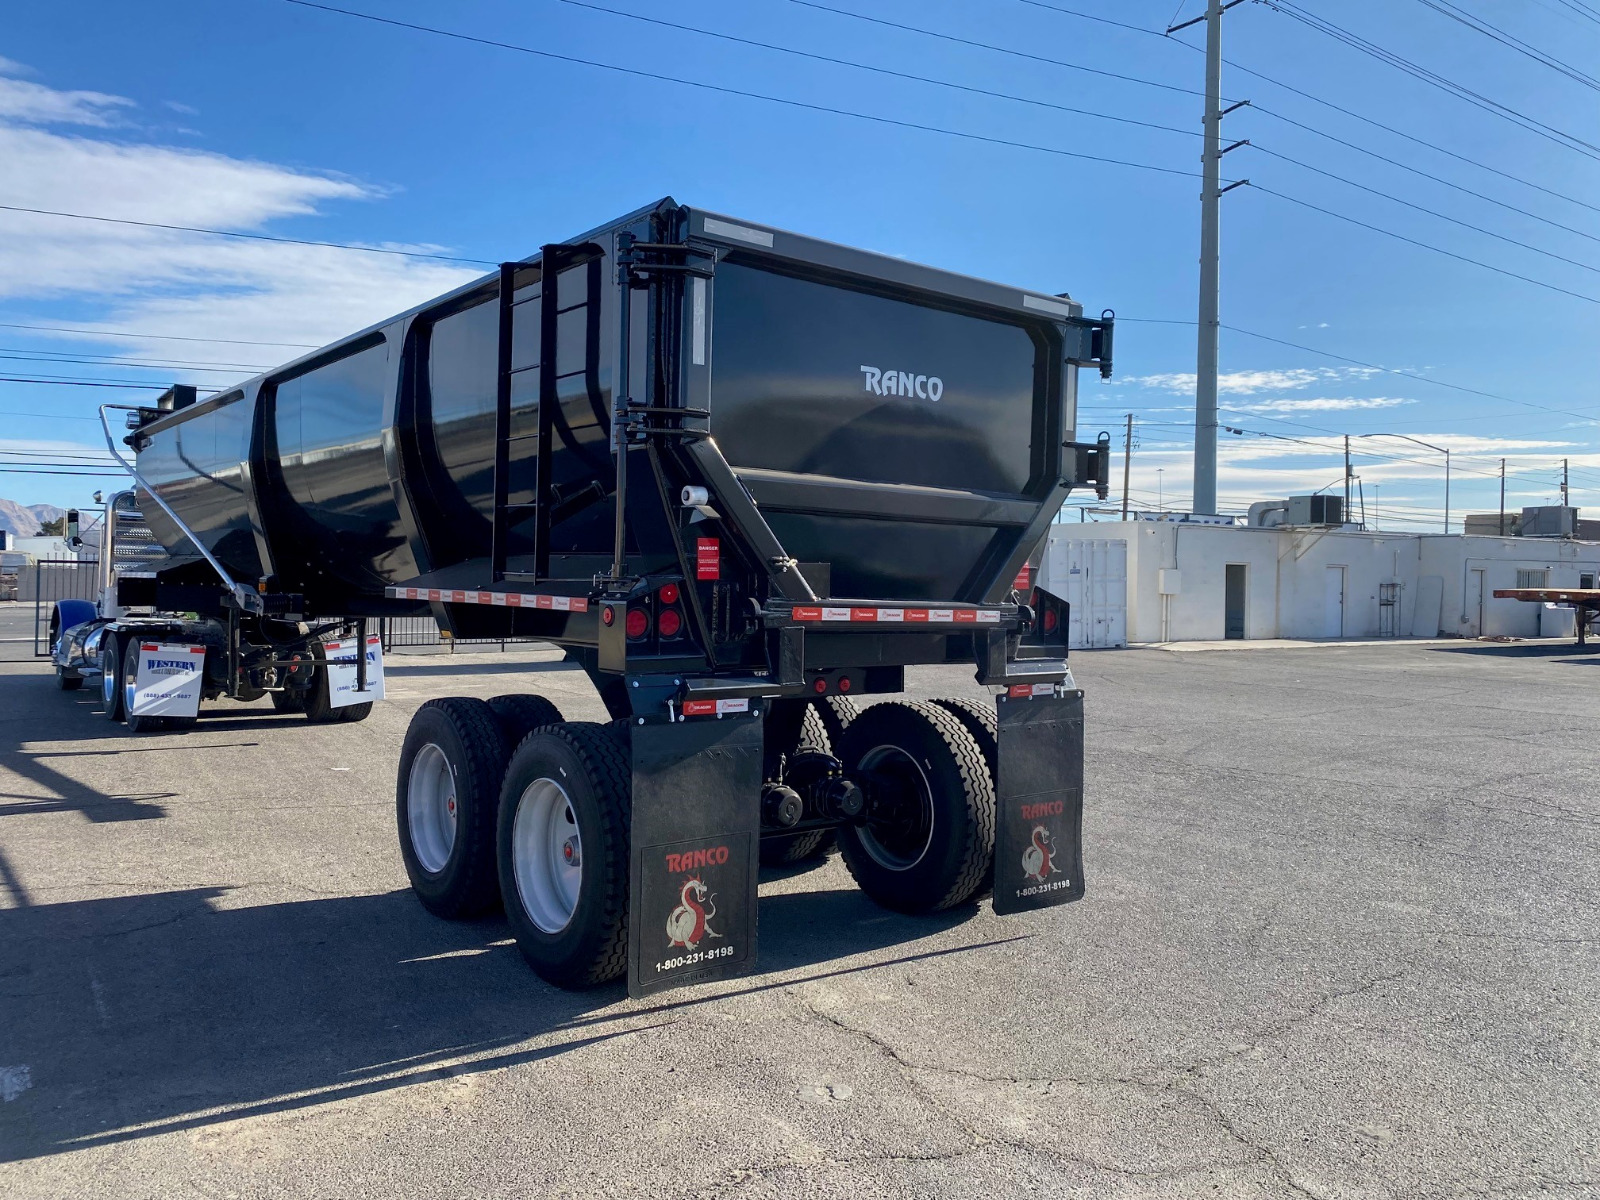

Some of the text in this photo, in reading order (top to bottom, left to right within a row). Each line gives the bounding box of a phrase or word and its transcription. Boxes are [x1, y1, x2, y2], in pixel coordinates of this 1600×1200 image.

[861, 365, 944, 402] RANCO
[148, 659, 196, 672] WESTERN
[1021, 800, 1063, 820] RANCO
[666, 846, 729, 872] RANCO
[1016, 880, 1070, 898] 1-800-231-8198
[656, 946, 734, 972] 1-800-231-8198
